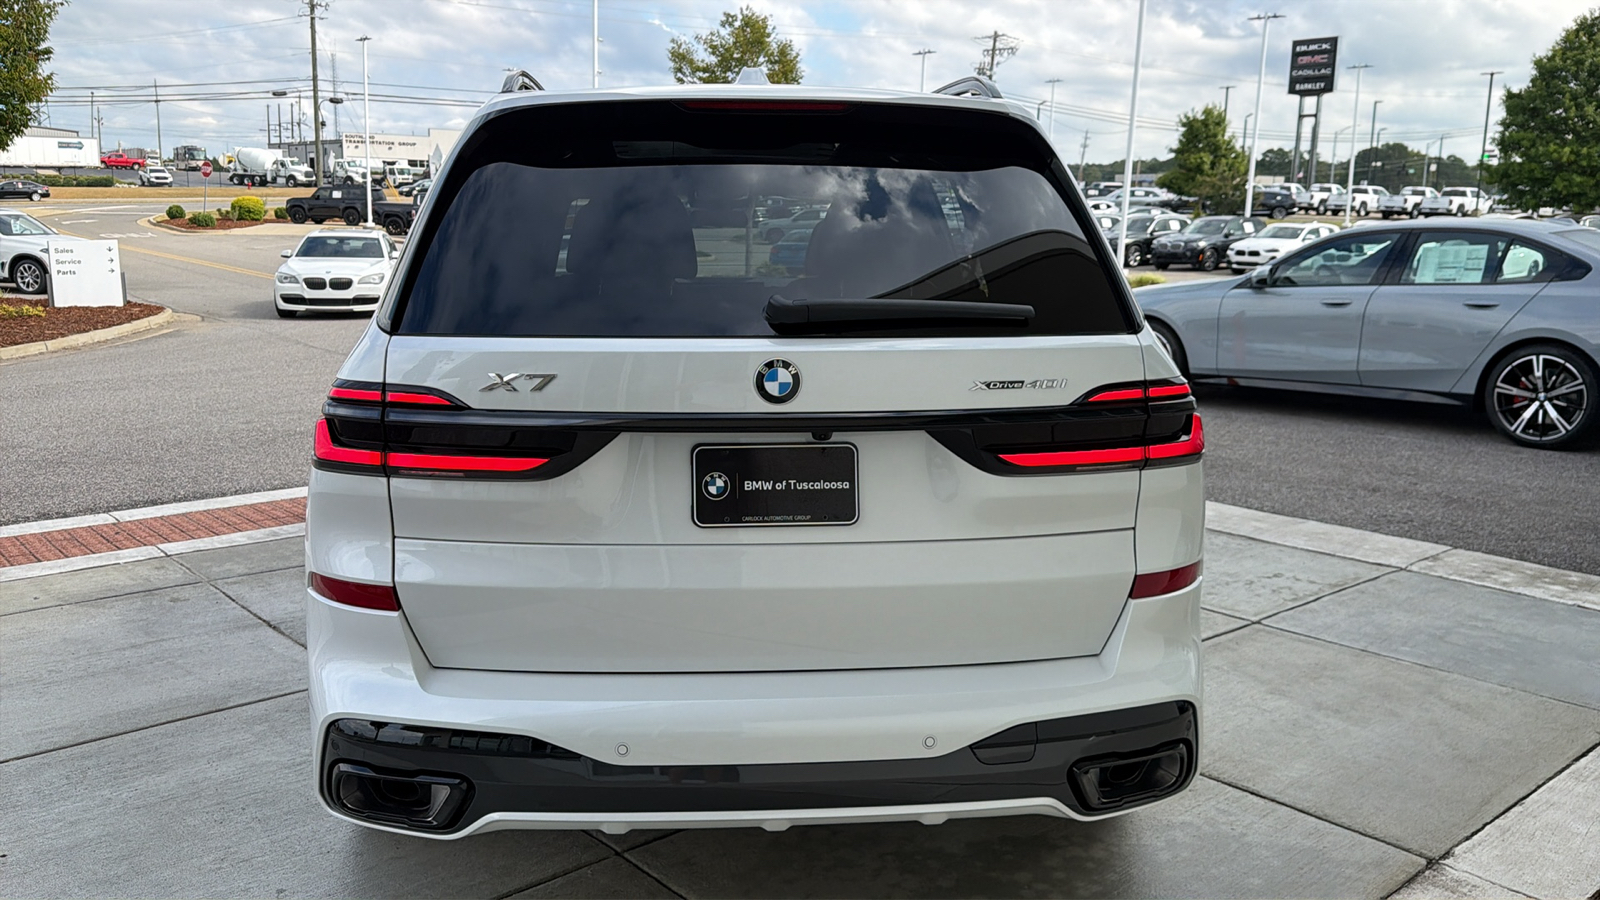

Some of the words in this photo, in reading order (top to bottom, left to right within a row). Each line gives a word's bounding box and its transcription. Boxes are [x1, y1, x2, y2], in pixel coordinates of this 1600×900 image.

[1296, 43, 1331, 51] BUICK
[1297, 54, 1329, 64] GMC
[1292, 68, 1332, 76] CADILLAC
[1295, 82, 1325, 91] BARKLEY
[478, 372, 558, 392] X7
[744, 480, 773, 491] BMW
[775, 480, 787, 491] of
[788, 479, 850, 490] Tuscaloosa
